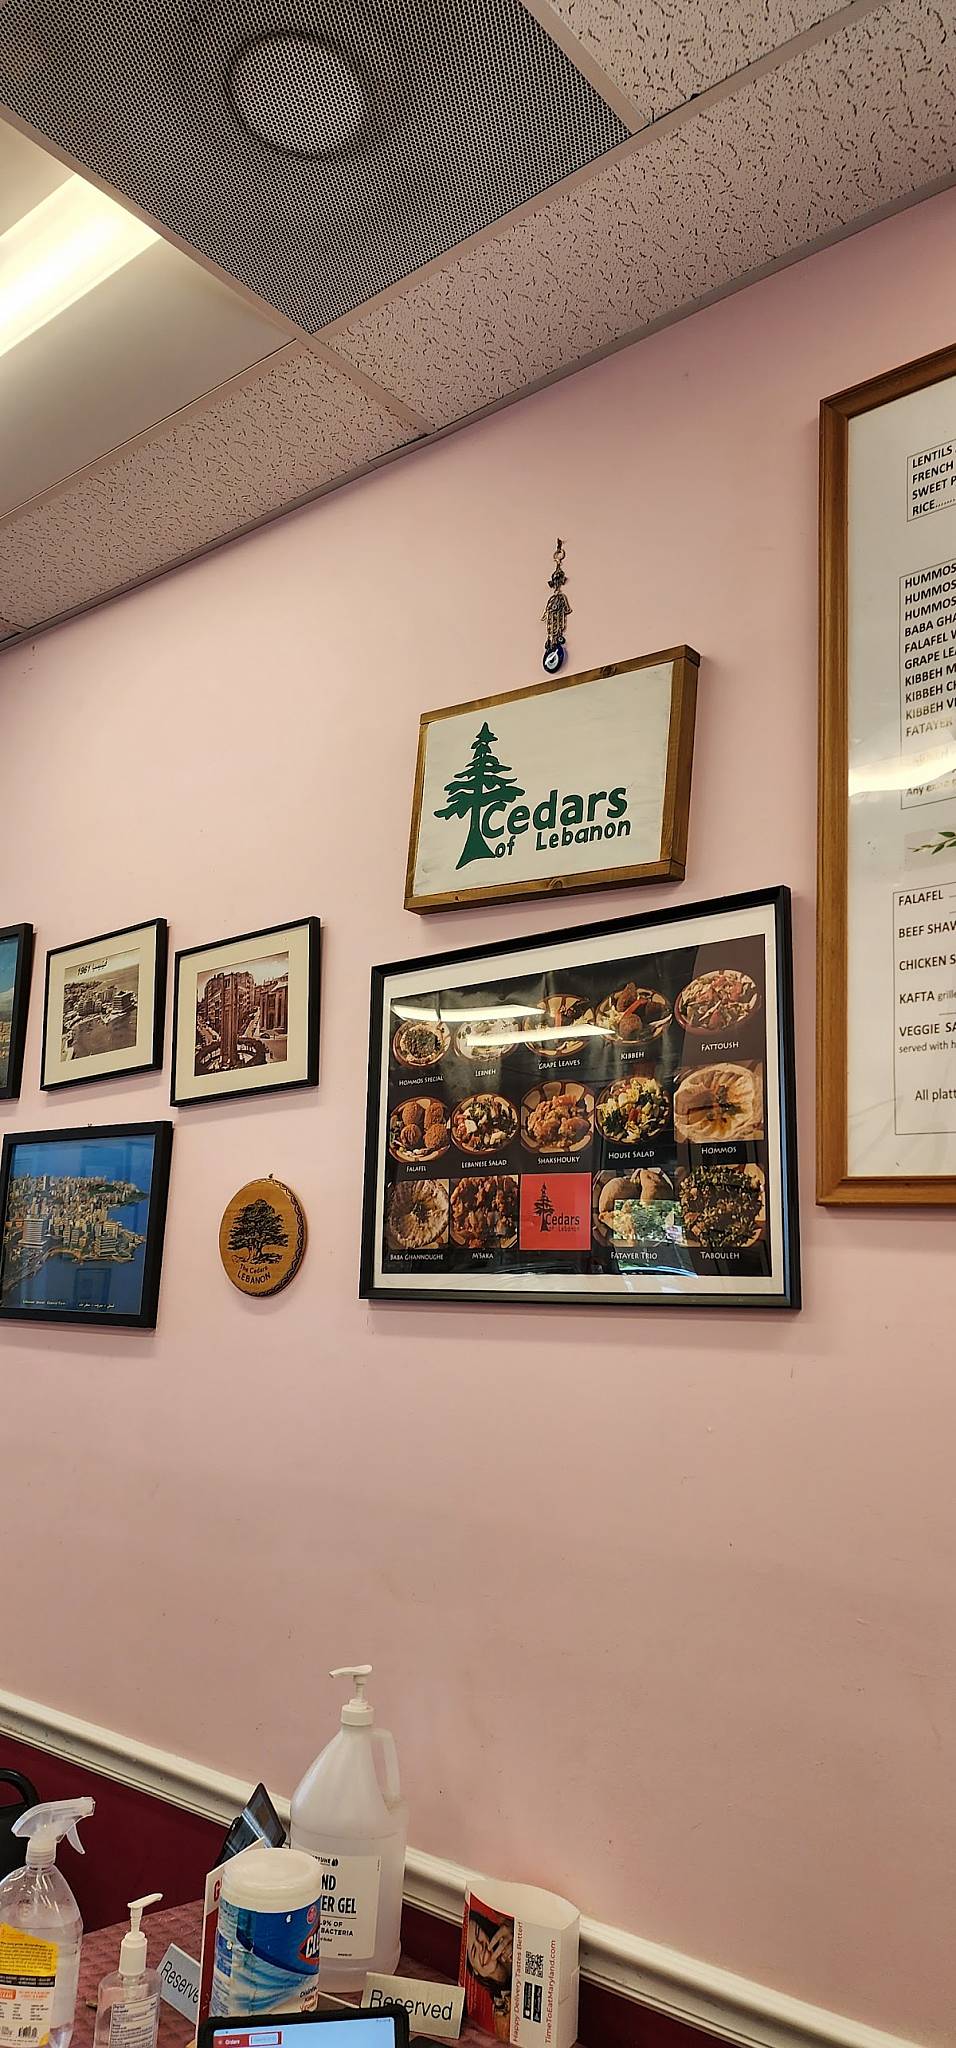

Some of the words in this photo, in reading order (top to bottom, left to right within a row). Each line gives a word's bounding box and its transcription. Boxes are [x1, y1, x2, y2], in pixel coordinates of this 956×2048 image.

[912, 445, 952, 468] LENTILS
[912, 460, 954, 484] FRENCH
[912, 478, 948, 500] SWEET
[905, 563, 956, 589] HUMMOS
[905, 579, 956, 605] HUMMOS
[905, 596, 956, 621] HUMMOS
[905, 620, 934, 637] BABA
[905, 632, 948, 654] FALAFEL
[905, 651, 940, 670] GRAPE
[905, 667, 943, 687] KIBBEH
[905, 684, 943, 703] KIBBEH
[905, 701, 943, 720] KIBBEH
[481, 787, 629, 839] Cedars
[494, 835, 516, 858] of
[535, 819, 632, 851] Lebanon
[898, 889, 944, 906] FALAFEL
[898, 925, 925, 938] BEEF
[899, 955, 946, 971] CHICKEN
[899, 990, 935, 1005] KAFTA
[899, 1023, 940, 1037] VEGGIE
[701, 1041, 739, 1052] FATTOUSH
[899, 1042, 927, 1054] served
[930, 1039, 948, 1051] with
[620, 1051, 645, 1061] KIBBEH
[538, 1061, 558, 1070] GRAPE
[558, 1059, 581, 1068] LEAVES
[398, 1077, 424, 1087] HOMMOS
[915, 1088, 929, 1101] All
[608, 1151, 631, 1160] HOUSE
[632, 1150, 655, 1159] SALAD
[701, 1146, 737, 1155] HOMMOS
[461, 1160, 488, 1169] LEBANESE
[488, 1159, 508, 1168] SALAD
[537, 1155, 581, 1165] SHAKSHOUKY
[406, 1164, 427, 1173] FALAFEL
[545, 1212, 580, 1226] Cedars
[610, 1251, 640, 1260] FATAYER
[641, 1251, 658, 1260] TRIO
[700, 1251, 740, 1260] TABOULEH
[237, 1270, 272, 1285] LEBANON
[337, 1897, 357, 1914] GEL
[320, 1928, 354, 1937] BACTERIA
[513, 1979, 522, 2011] Delivery
[545, 1939, 556, 2043] TimeToEatMaryland.com
